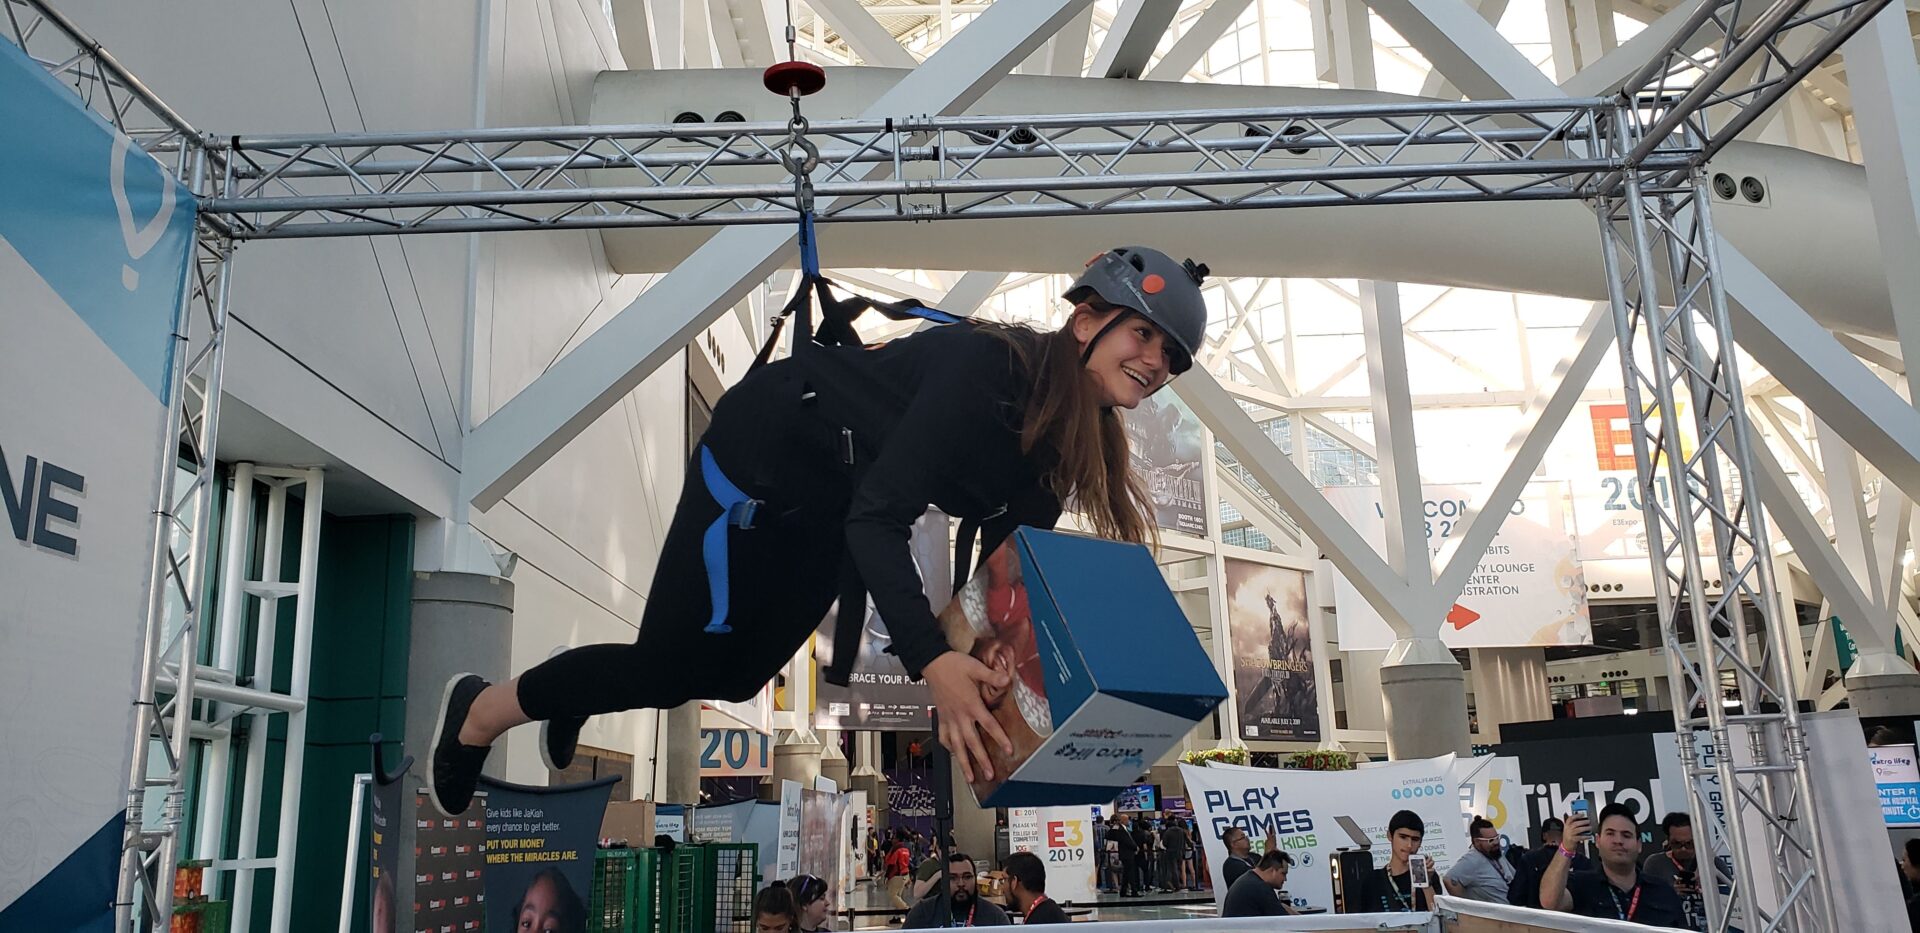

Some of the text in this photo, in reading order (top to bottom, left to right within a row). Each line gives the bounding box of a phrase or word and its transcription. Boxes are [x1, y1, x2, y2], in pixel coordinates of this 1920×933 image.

[1178, 513, 1194, 522] BOOTH
[1485, 545, 1510, 555] IBITS
[1490, 563, 1536, 573] LOUNGE
[1467, 575, 1500, 585] ENTER
[1461, 585, 1520, 596] ISTRATION
[849, 673, 876, 684] BRACE
[878, 674, 903, 685] YOUR
[700, 730, 769, 769] 201
[1702, 744, 1719, 785] PLY
[1878, 788, 1906, 796] NTER
[1204, 786, 1280, 813] PLAY
[1521, 777, 1666, 829] TikTo
[486, 808, 499, 818] Give
[500, 808, 512, 818] kids
[512, 808, 523, 818] like
[486, 823, 501, 833] every
[501, 822, 523, 832] chance
[523, 822, 530, 832] to
[530, 822, 541, 833] get
[1211, 809, 1314, 841] GAMES
[1047, 820, 1084, 848] E3
[486, 838, 545, 850] PUT YOUR MONEY
[1281, 833, 1318, 851] KIDS
[486, 853, 510, 864] WHERE
[510, 852, 523, 862] THE
[524, 851, 560, 862] MIRACLES
[1048, 848, 1085, 862] 2019
